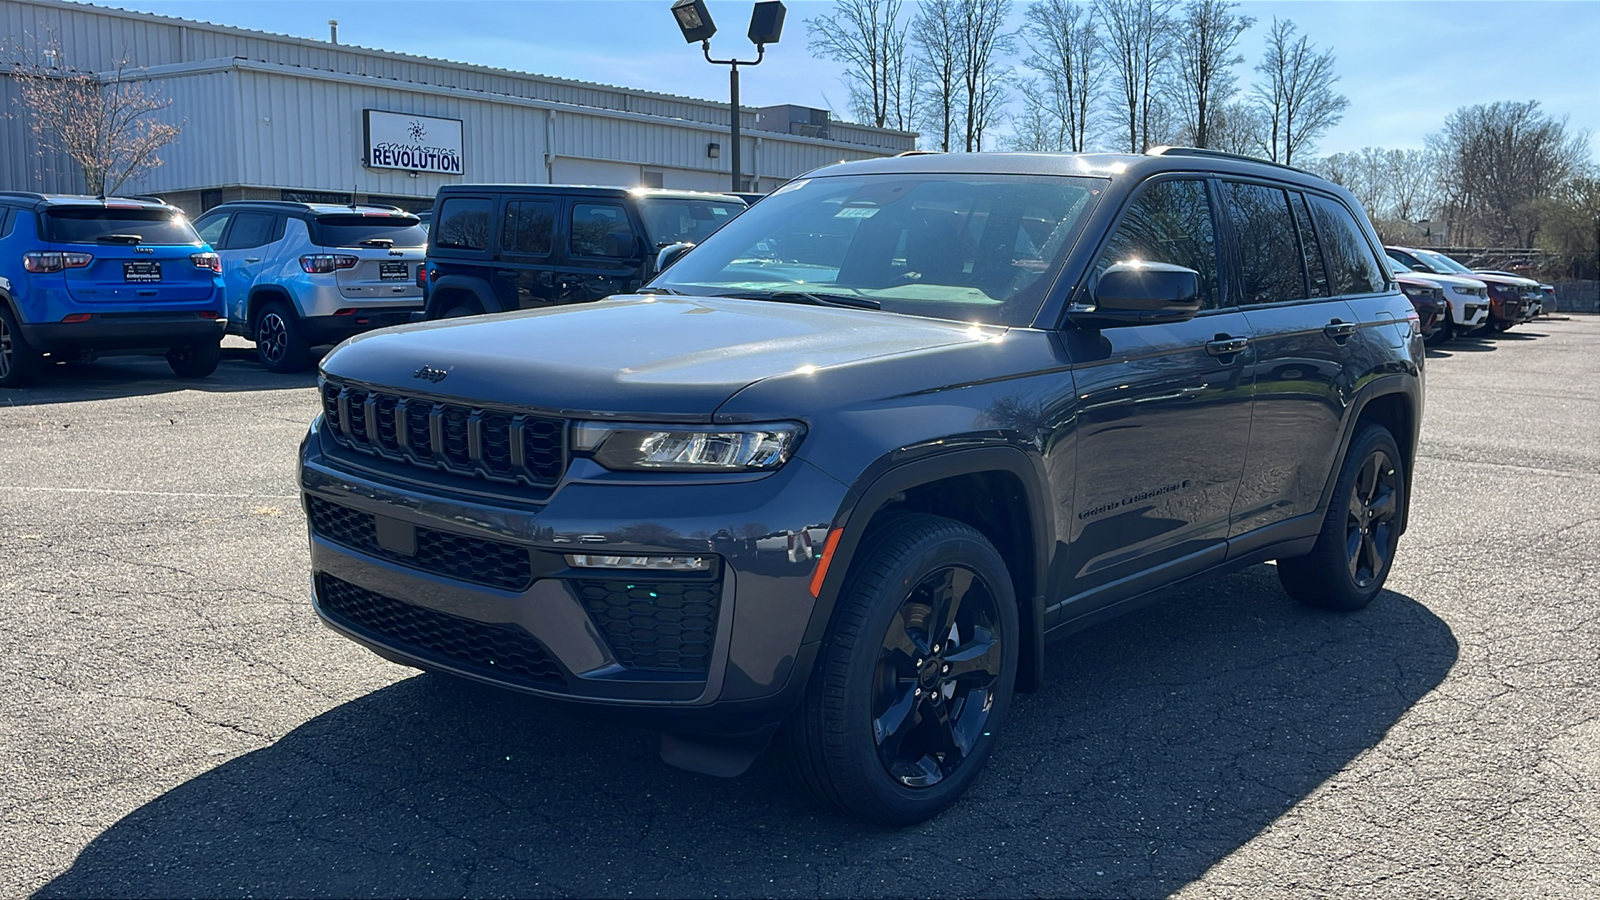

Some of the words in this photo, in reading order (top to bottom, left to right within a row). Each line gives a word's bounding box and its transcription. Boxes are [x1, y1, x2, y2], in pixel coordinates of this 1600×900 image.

[376, 142, 456, 156] GYMNASTICS
[373, 148, 460, 171] REVOLUTION
[413, 364, 448, 384] Jeep
